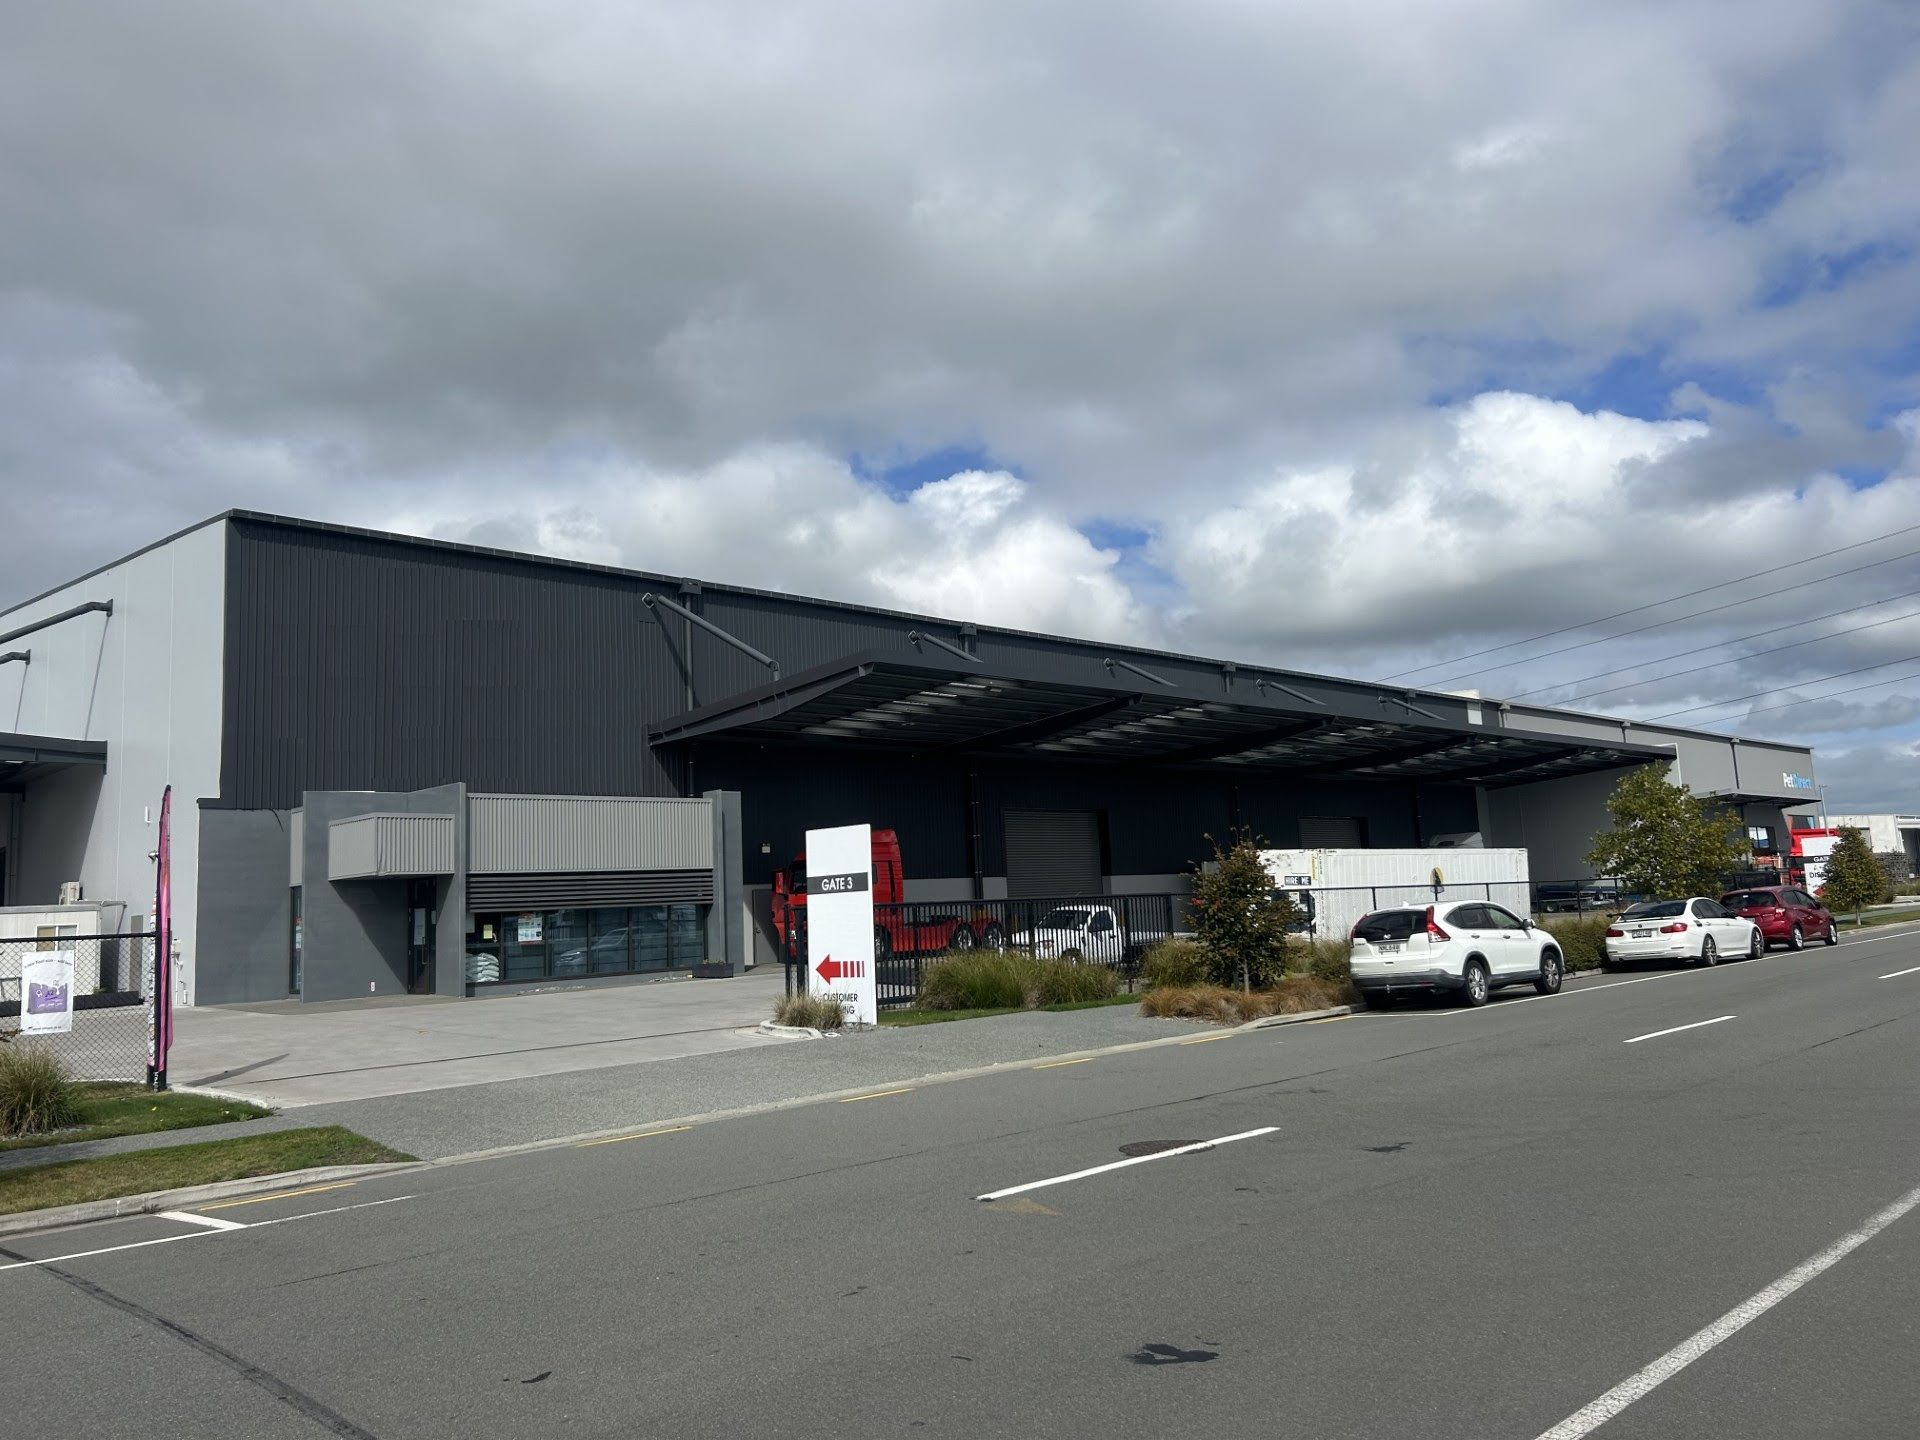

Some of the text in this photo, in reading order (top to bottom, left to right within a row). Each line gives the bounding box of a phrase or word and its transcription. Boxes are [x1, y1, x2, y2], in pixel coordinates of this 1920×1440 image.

[821, 876, 853, 891] GATE 3
[823, 992, 858, 1002] CUSTOMER
